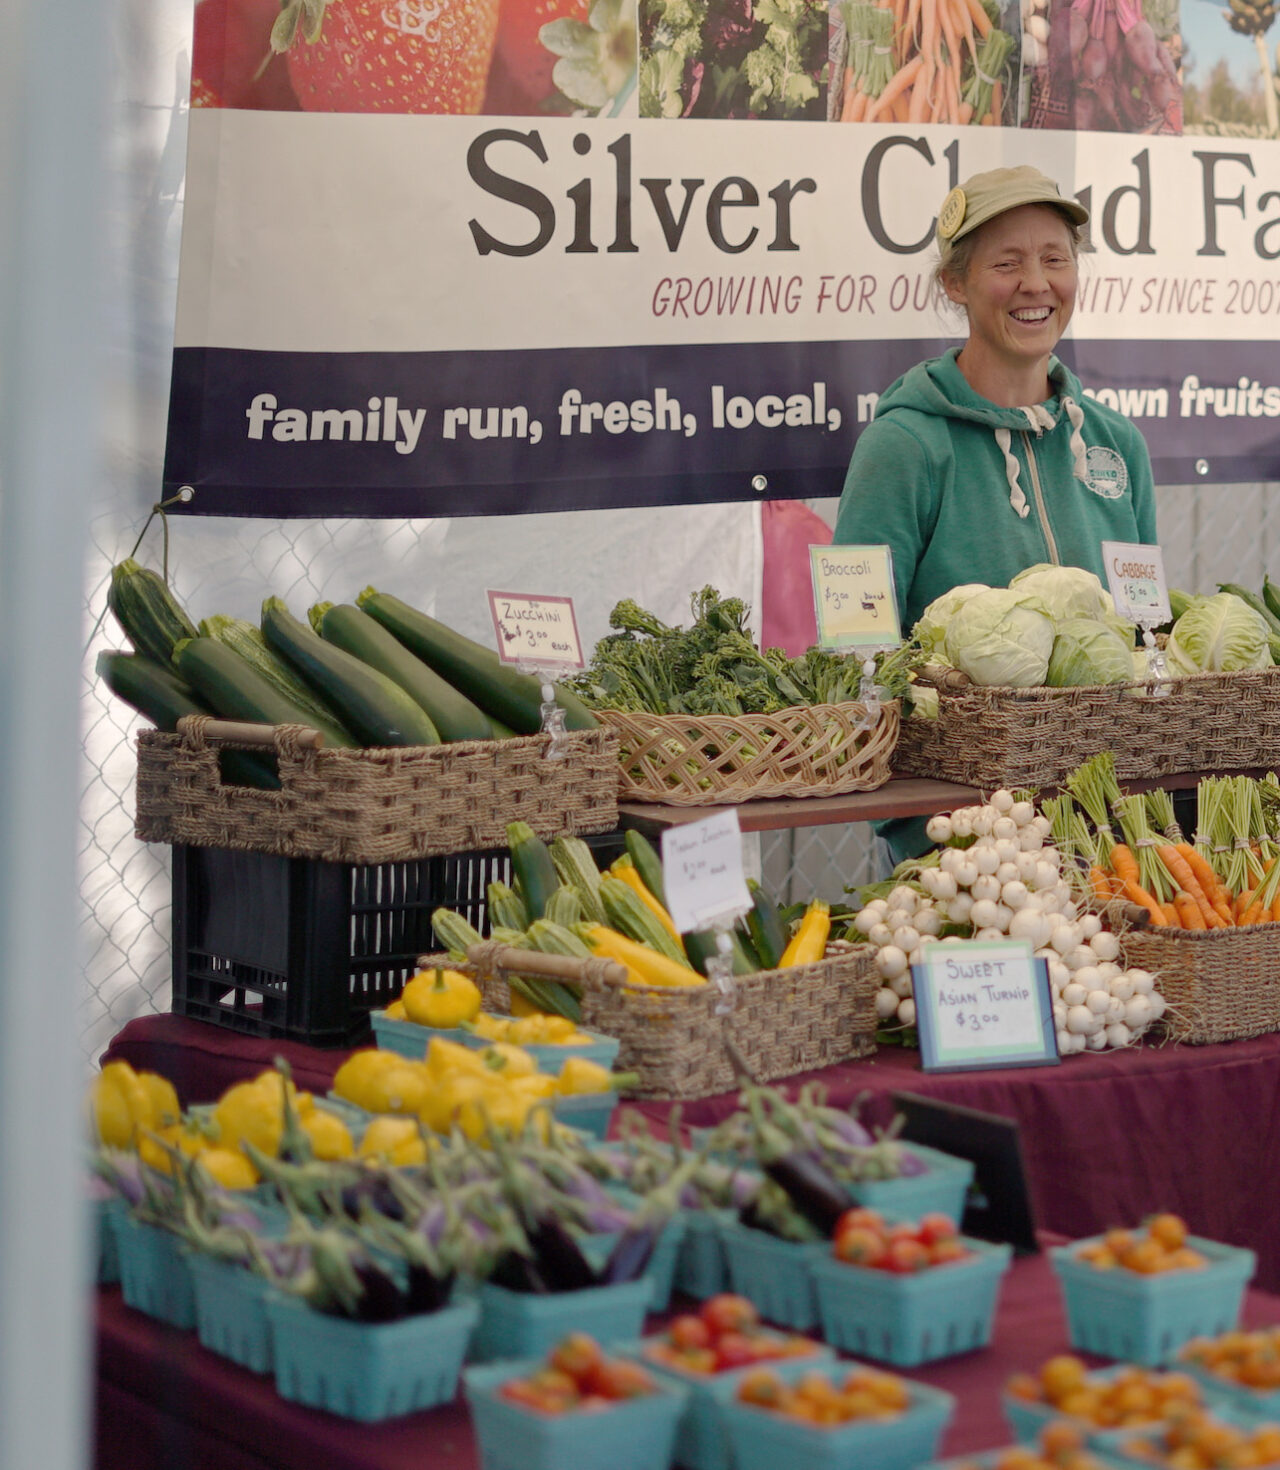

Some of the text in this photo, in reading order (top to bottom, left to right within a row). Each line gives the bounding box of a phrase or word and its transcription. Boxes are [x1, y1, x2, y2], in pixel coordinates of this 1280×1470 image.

[467, 129, 818, 257] Silver
[651, 275, 803, 318] GROWING
[816, 274, 877, 314] FOR
[1140, 277, 1217, 314] SINCE
[246, 393, 426, 455] family
[443, 405, 543, 445] run,
[559, 387, 697, 437] fresh,
[712, 382, 842, 431] local,
[1113, 557, 1158, 581] CABBAGE
[502, 602, 562, 623] ZUCCHINI
[551, 640, 573, 653] each
[946, 958, 1006, 980] SWEET
